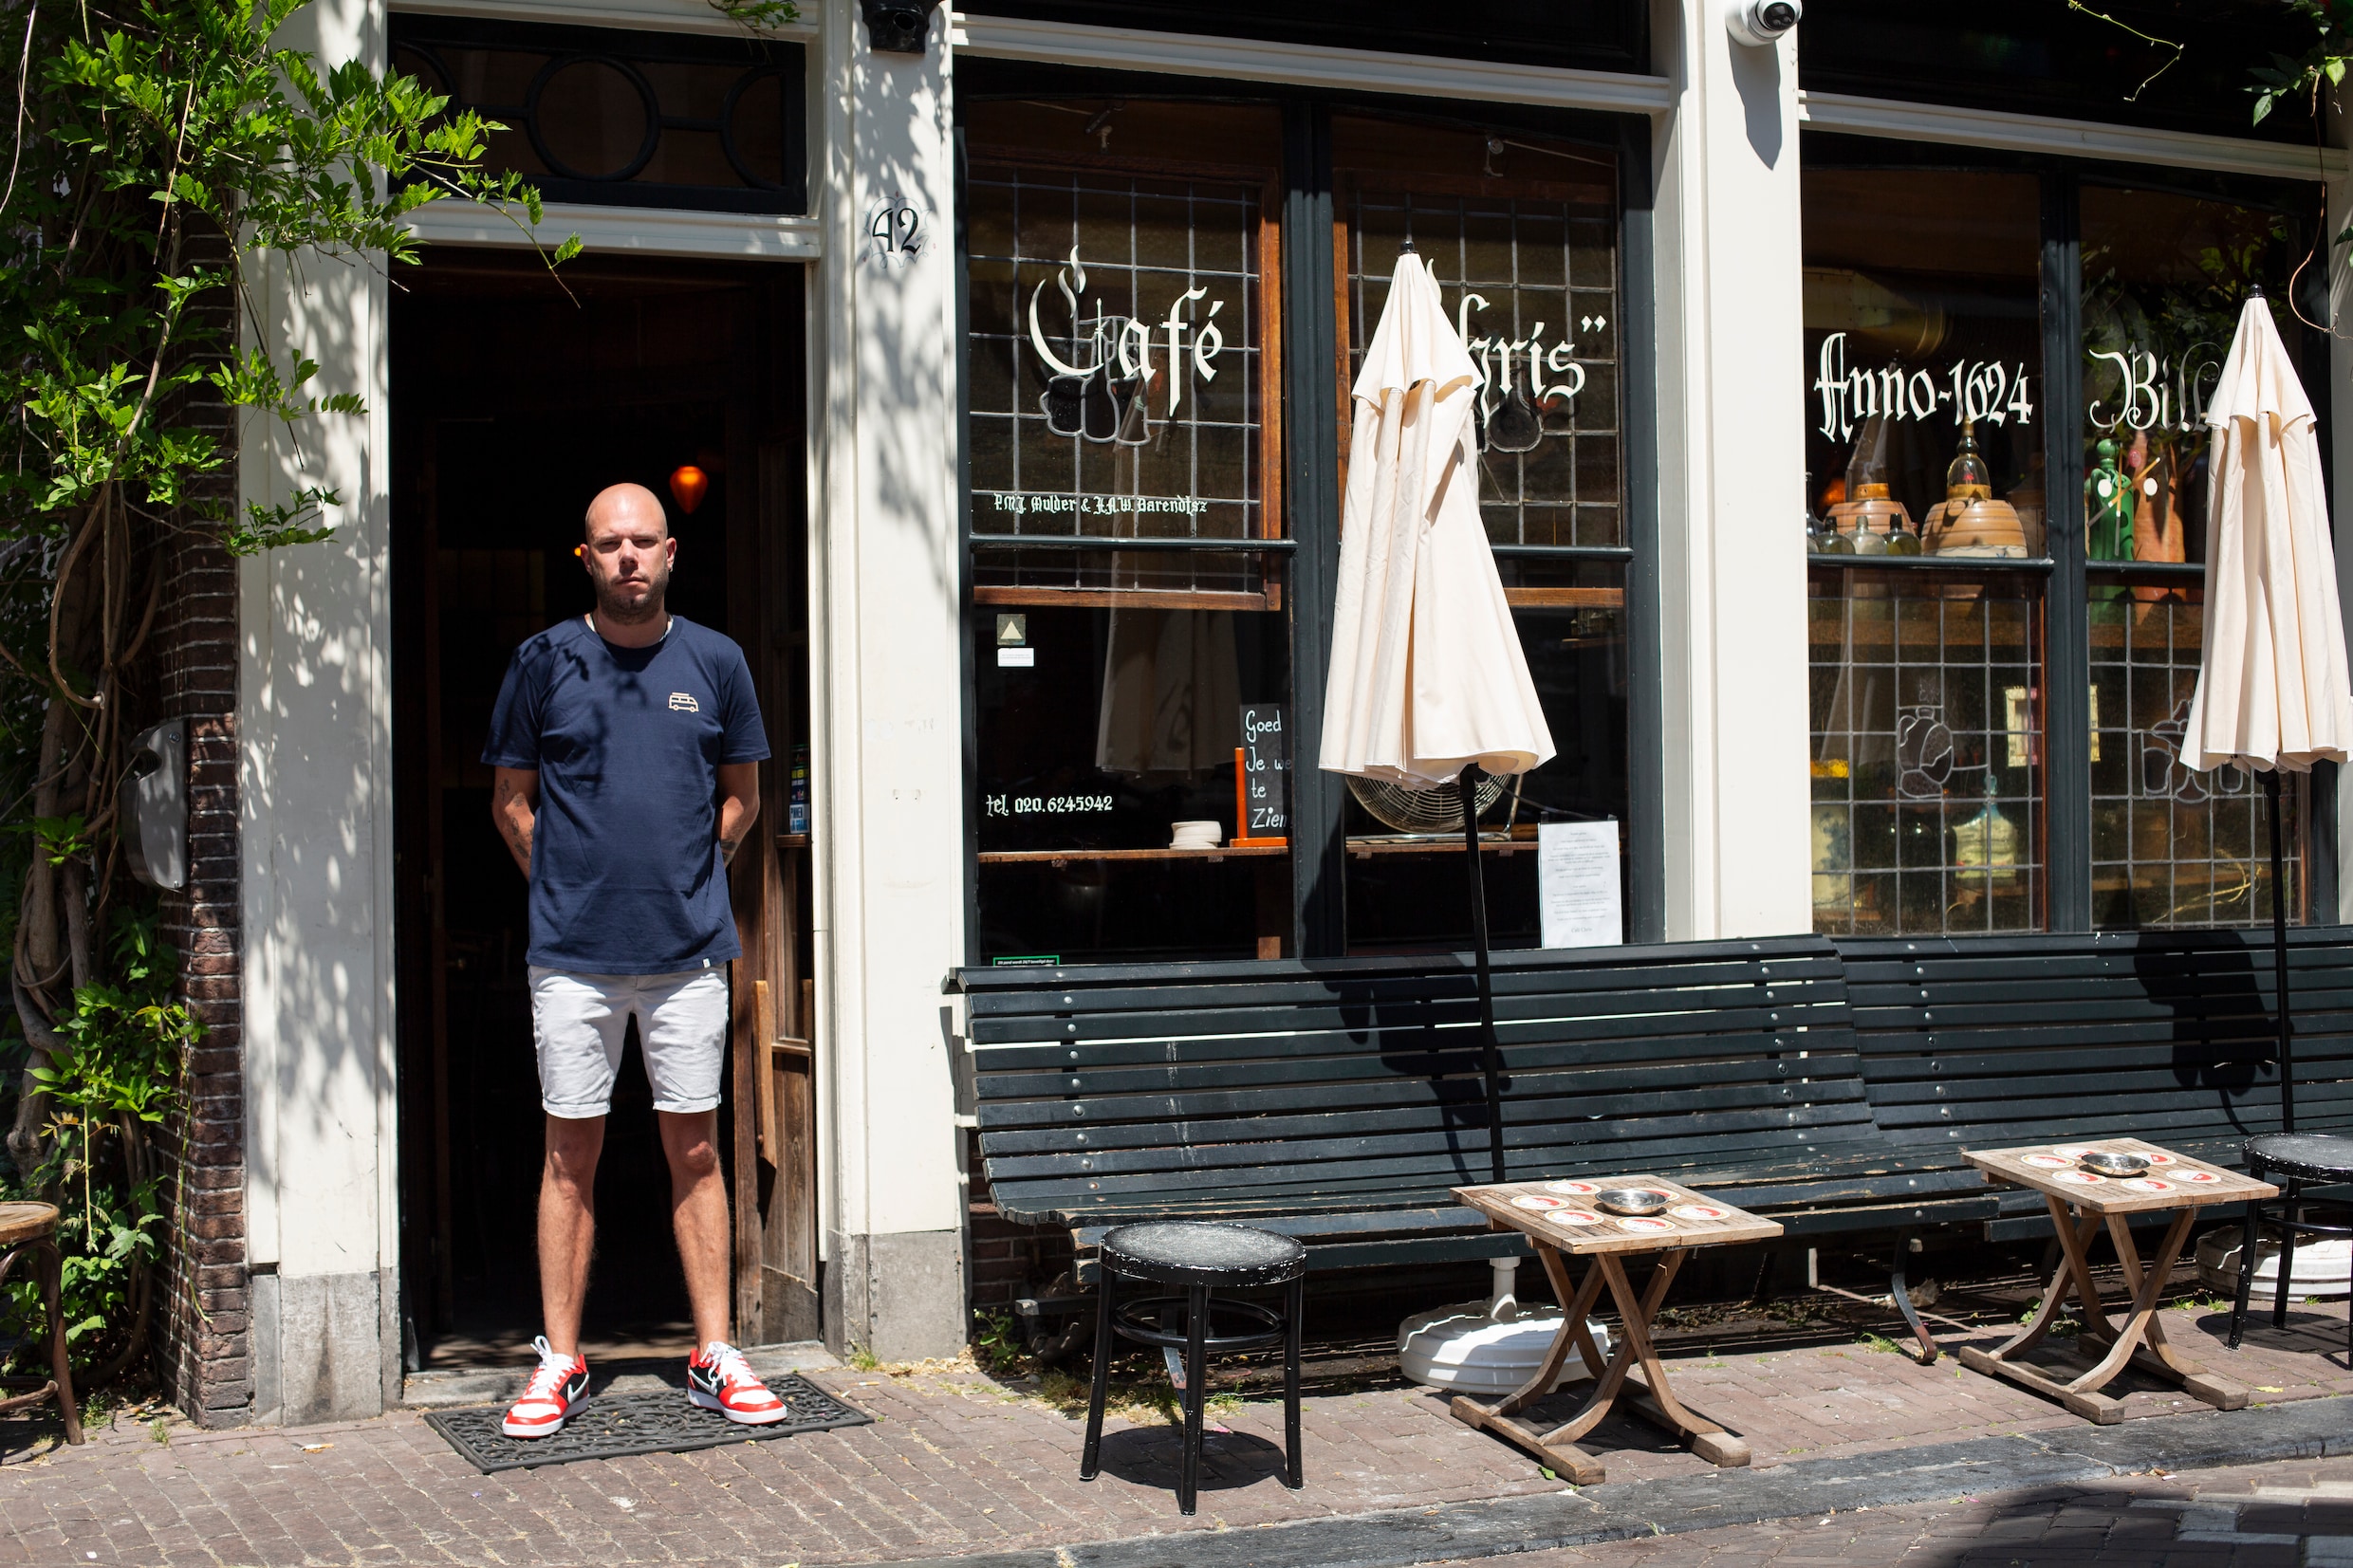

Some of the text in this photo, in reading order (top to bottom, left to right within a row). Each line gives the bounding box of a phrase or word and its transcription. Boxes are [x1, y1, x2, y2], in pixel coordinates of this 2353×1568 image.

[872, 207, 921, 255] 42
[1028, 245, 1607, 430] Café hris"
[1030, 494, 1078, 514] Mulder
[1081, 497, 1091, 513] &
[1245, 710, 1283, 743] Goed
[1245, 746, 1266, 772] Je
[1251, 777, 1267, 799] te
[986, 794, 1010, 817] tel.
